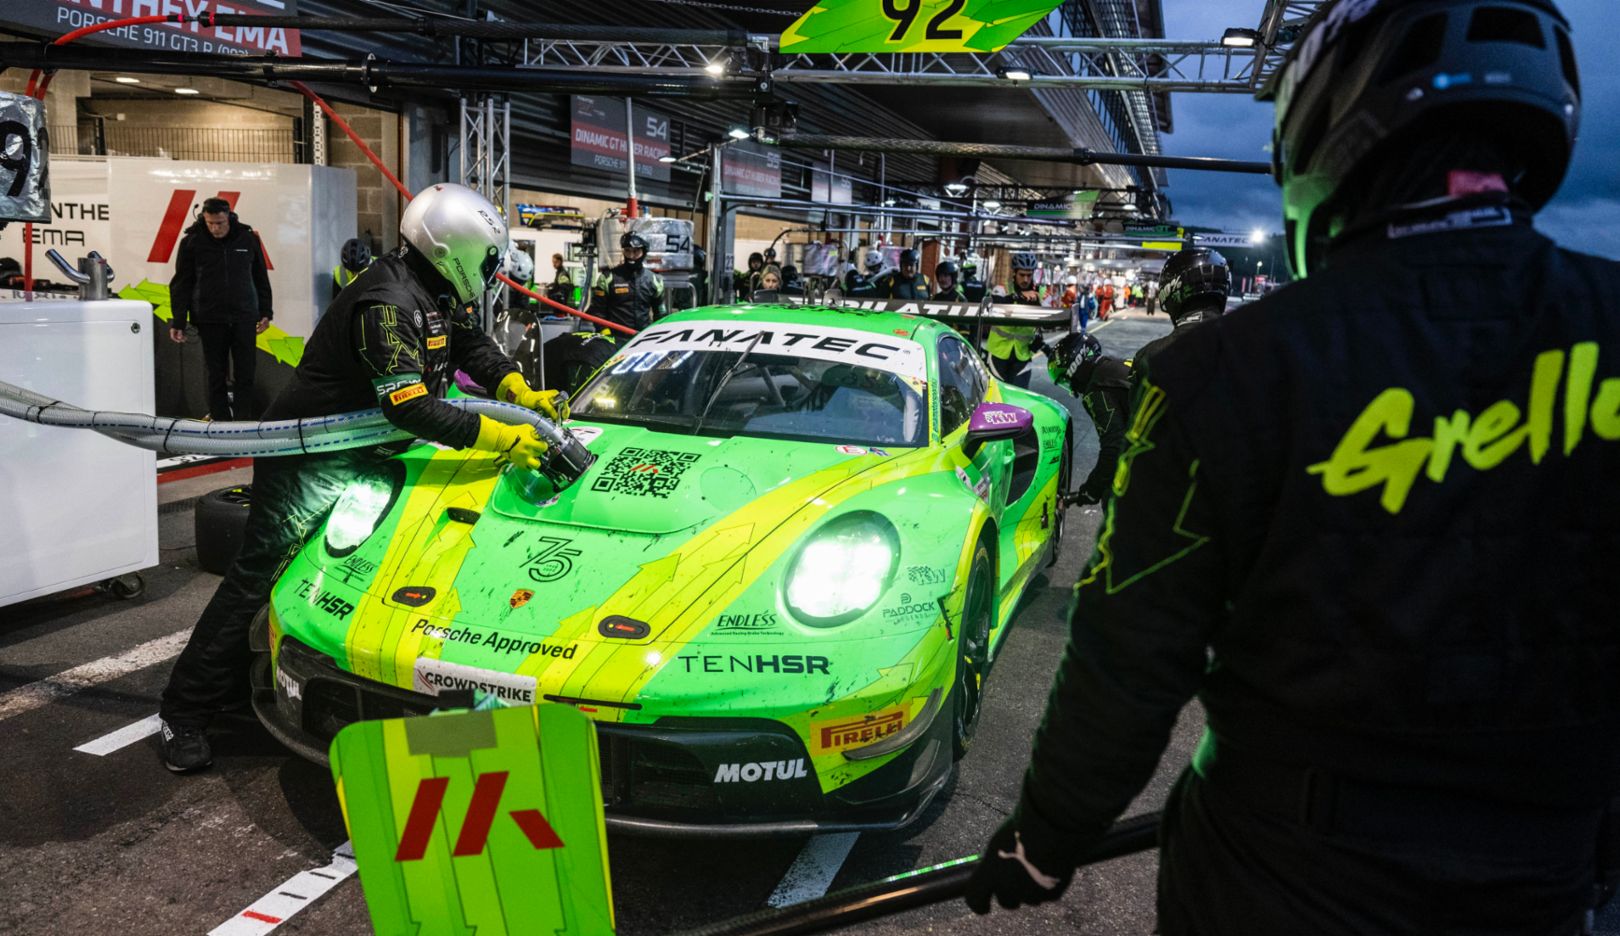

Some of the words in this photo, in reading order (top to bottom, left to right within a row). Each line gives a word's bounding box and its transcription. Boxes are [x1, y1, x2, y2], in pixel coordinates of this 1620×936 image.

[882, 0, 963, 41] 92
[144, 27, 166, 47] 911
[171, 33, 198, 53] GT3
[575, 128, 609, 149] DINAMIC
[609, 136, 620, 151] GT
[646, 116, 668, 141] 54
[0, 120, 32, 197] 9
[51, 202, 110, 221] NTHE
[22, 227, 86, 247] EMA
[665, 234, 691, 254] 54
[629, 328, 900, 361] FANATEC
[518, 535, 583, 583] 75
[717, 609, 777, 627] ENDLESS
[882, 601, 935, 618] PADDOCK
[411, 618, 482, 645] Porsche
[482, 631, 579, 660] Approved
[425, 671, 532, 703] CROWDSTRIKE
[820, 710, 904, 750] PIRELLI
[714, 758, 808, 784] MOTUL
